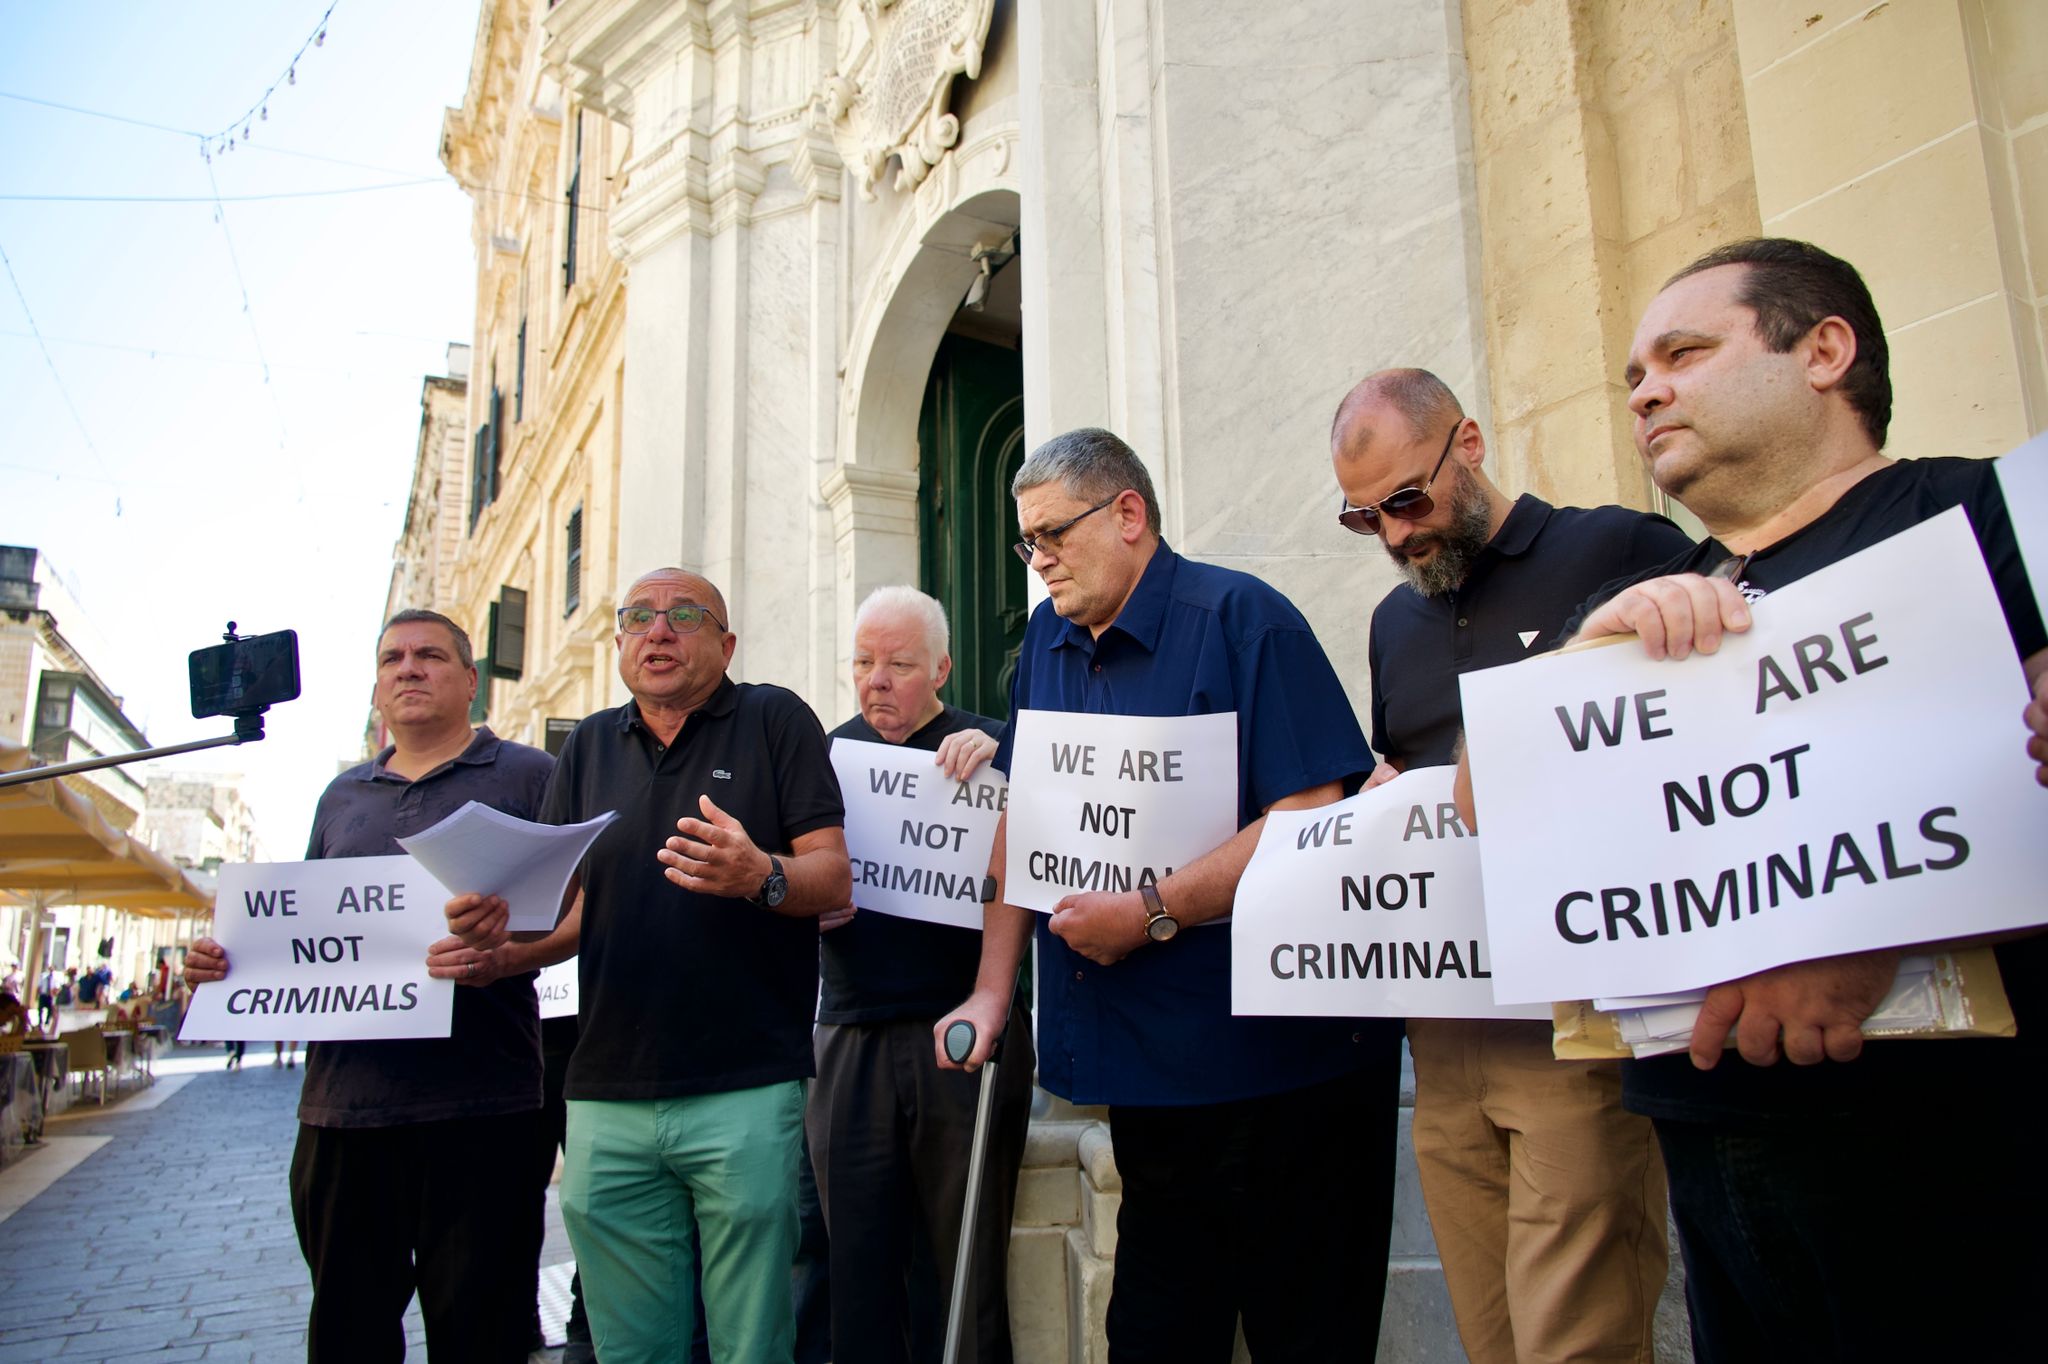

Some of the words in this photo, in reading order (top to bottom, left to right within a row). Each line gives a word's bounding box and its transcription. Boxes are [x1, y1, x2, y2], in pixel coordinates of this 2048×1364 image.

[1554, 689, 1674, 753] WE
[1755, 611, 1889, 715] ARE
[1051, 742, 1096, 777] WE
[1118, 749, 1184, 783] ARE
[869, 767, 919, 799] WE
[1663, 744, 1811, 833] NOT
[899, 819, 969, 853] NOT
[1079, 801, 1137, 840] NOT
[1297, 811, 1354, 851] WE
[1403, 802, 1479, 842] AR
[1341, 871, 1435, 912] NOT
[1554, 805, 1971, 945] CRIMINALS
[244, 889, 298, 918] WE
[336, 883, 406, 915] ARE
[291, 935, 364, 965] NOT
[226, 981, 419, 1015] CRIMINALS
